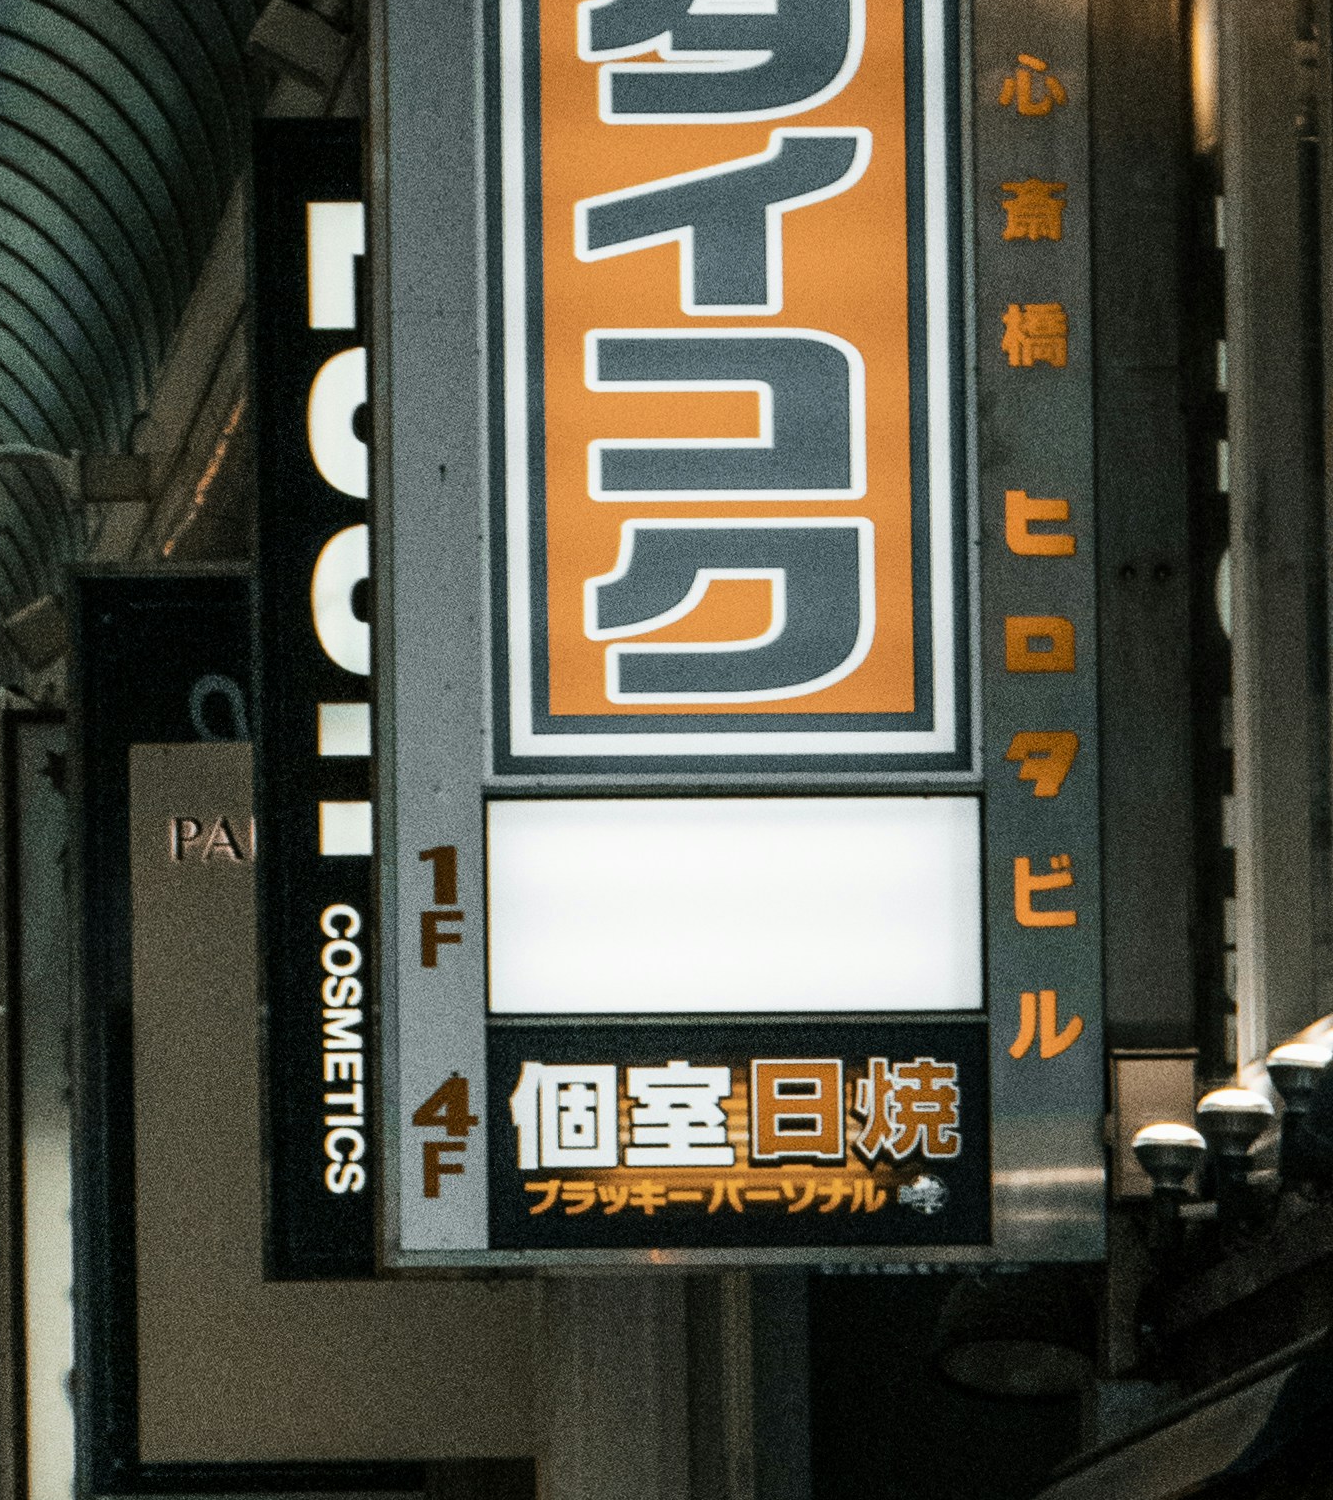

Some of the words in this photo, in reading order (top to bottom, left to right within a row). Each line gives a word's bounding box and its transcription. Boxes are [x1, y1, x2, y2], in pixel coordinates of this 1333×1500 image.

[1004, 490, 1083, 1062] ヒロタビル
[169, 815, 258, 863] PA
[419, 845, 465, 968] 1F
[319, 902, 365, 1195] COSMETICS
[412, 1076, 479, 1198] 4F
